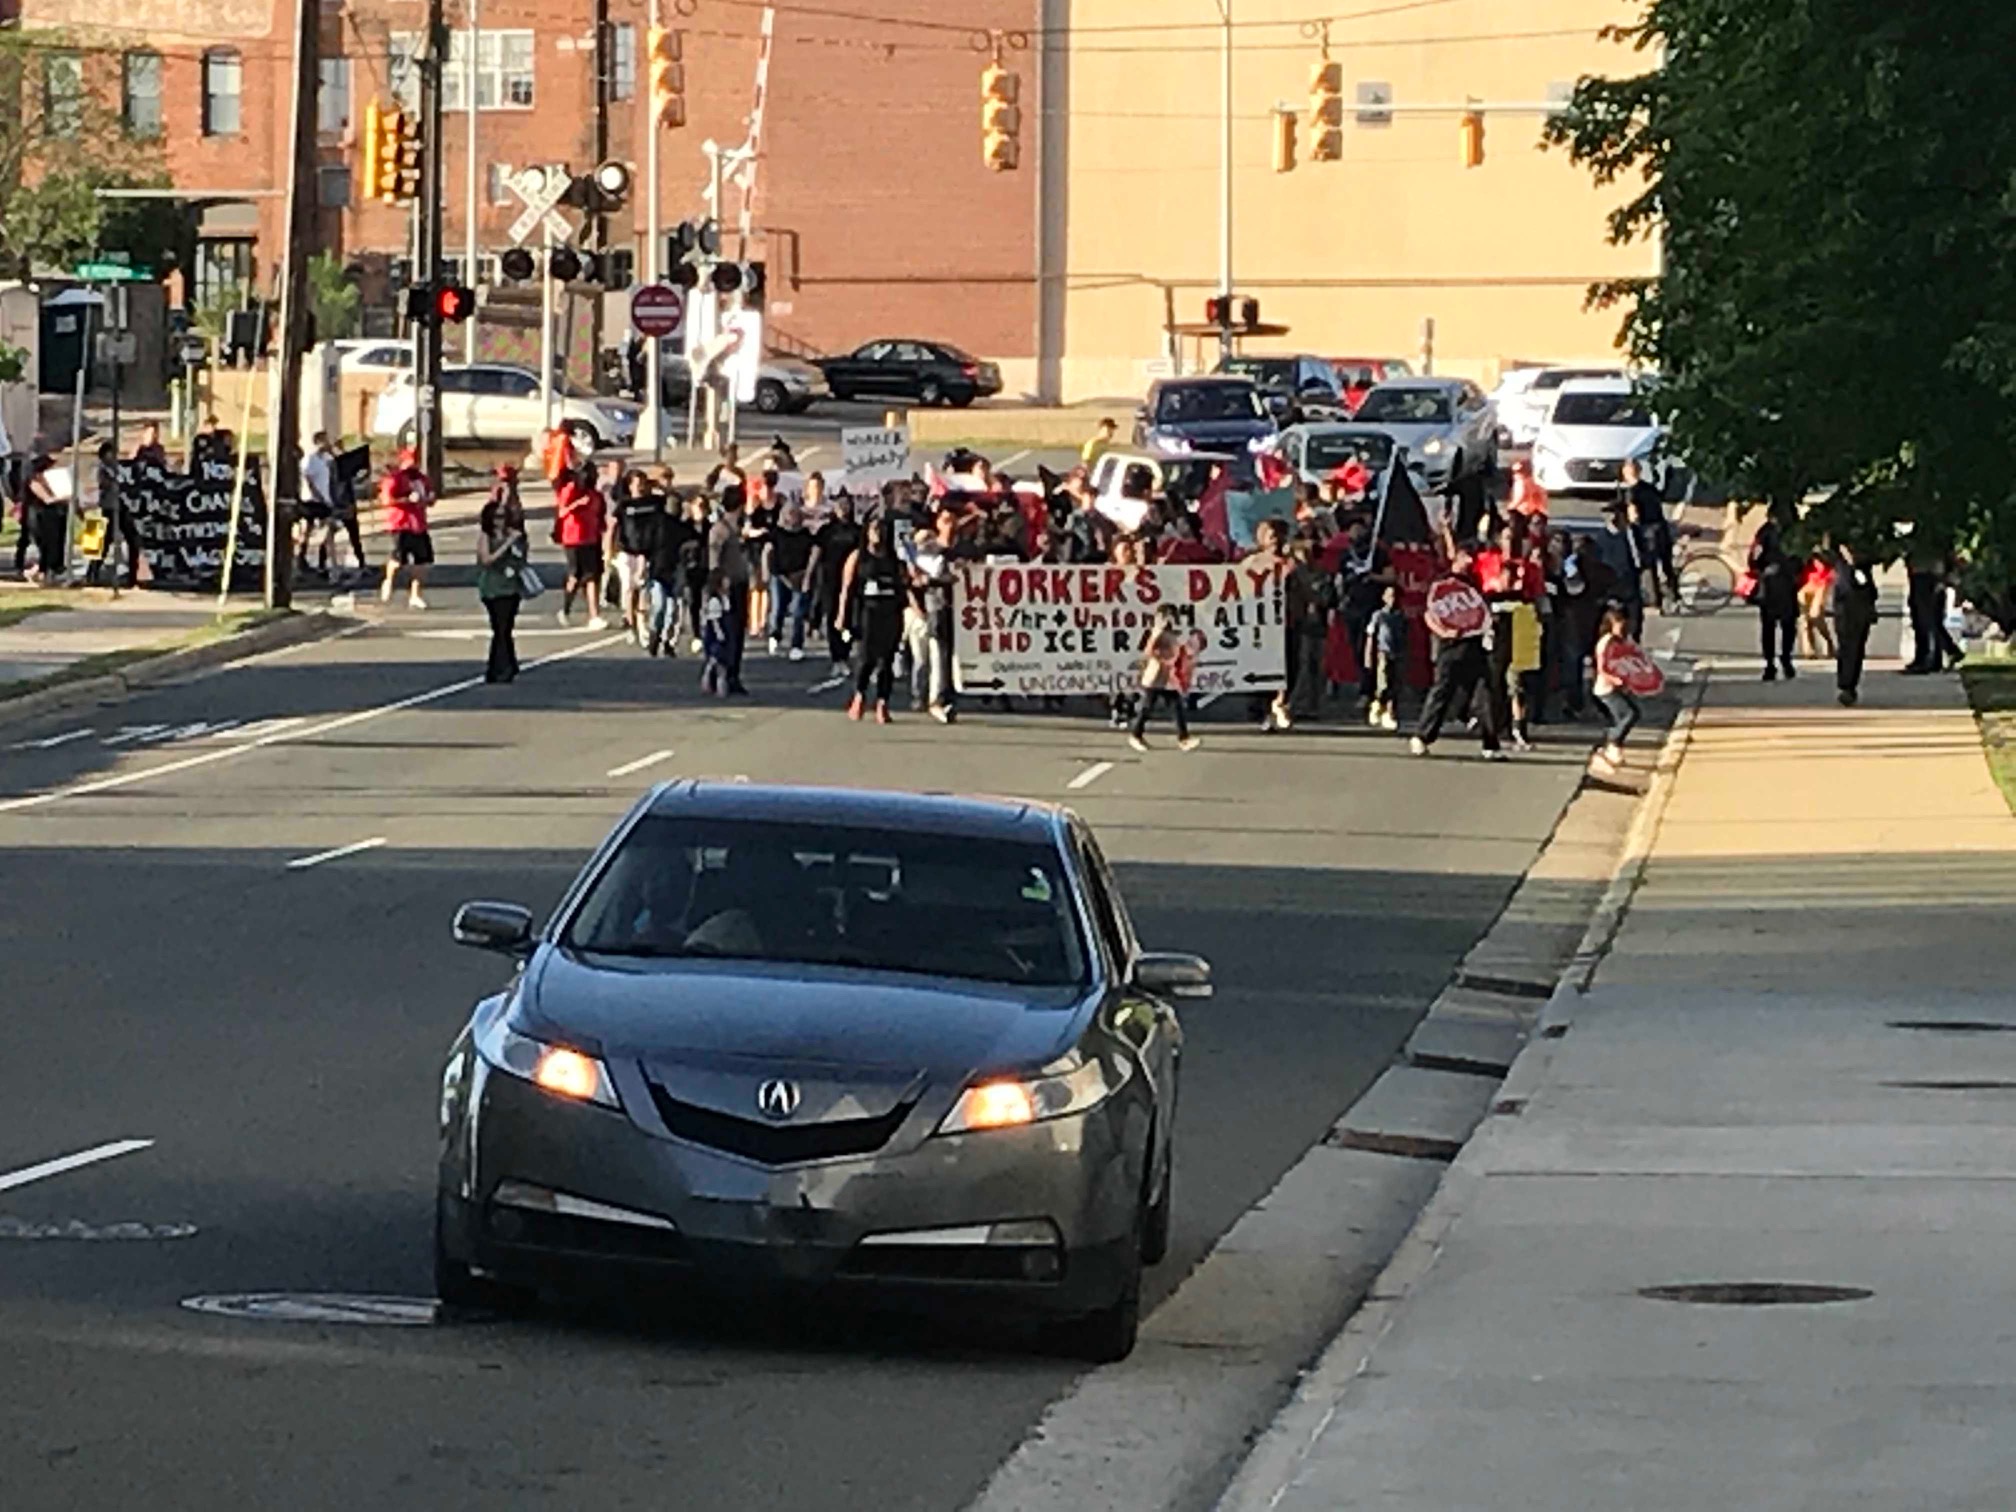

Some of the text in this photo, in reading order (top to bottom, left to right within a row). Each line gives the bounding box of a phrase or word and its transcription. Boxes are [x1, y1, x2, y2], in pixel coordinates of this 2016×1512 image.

[962, 561, 1283, 606] WORKERS DAY!
[978, 626, 1263, 653] END ICE RDS!
